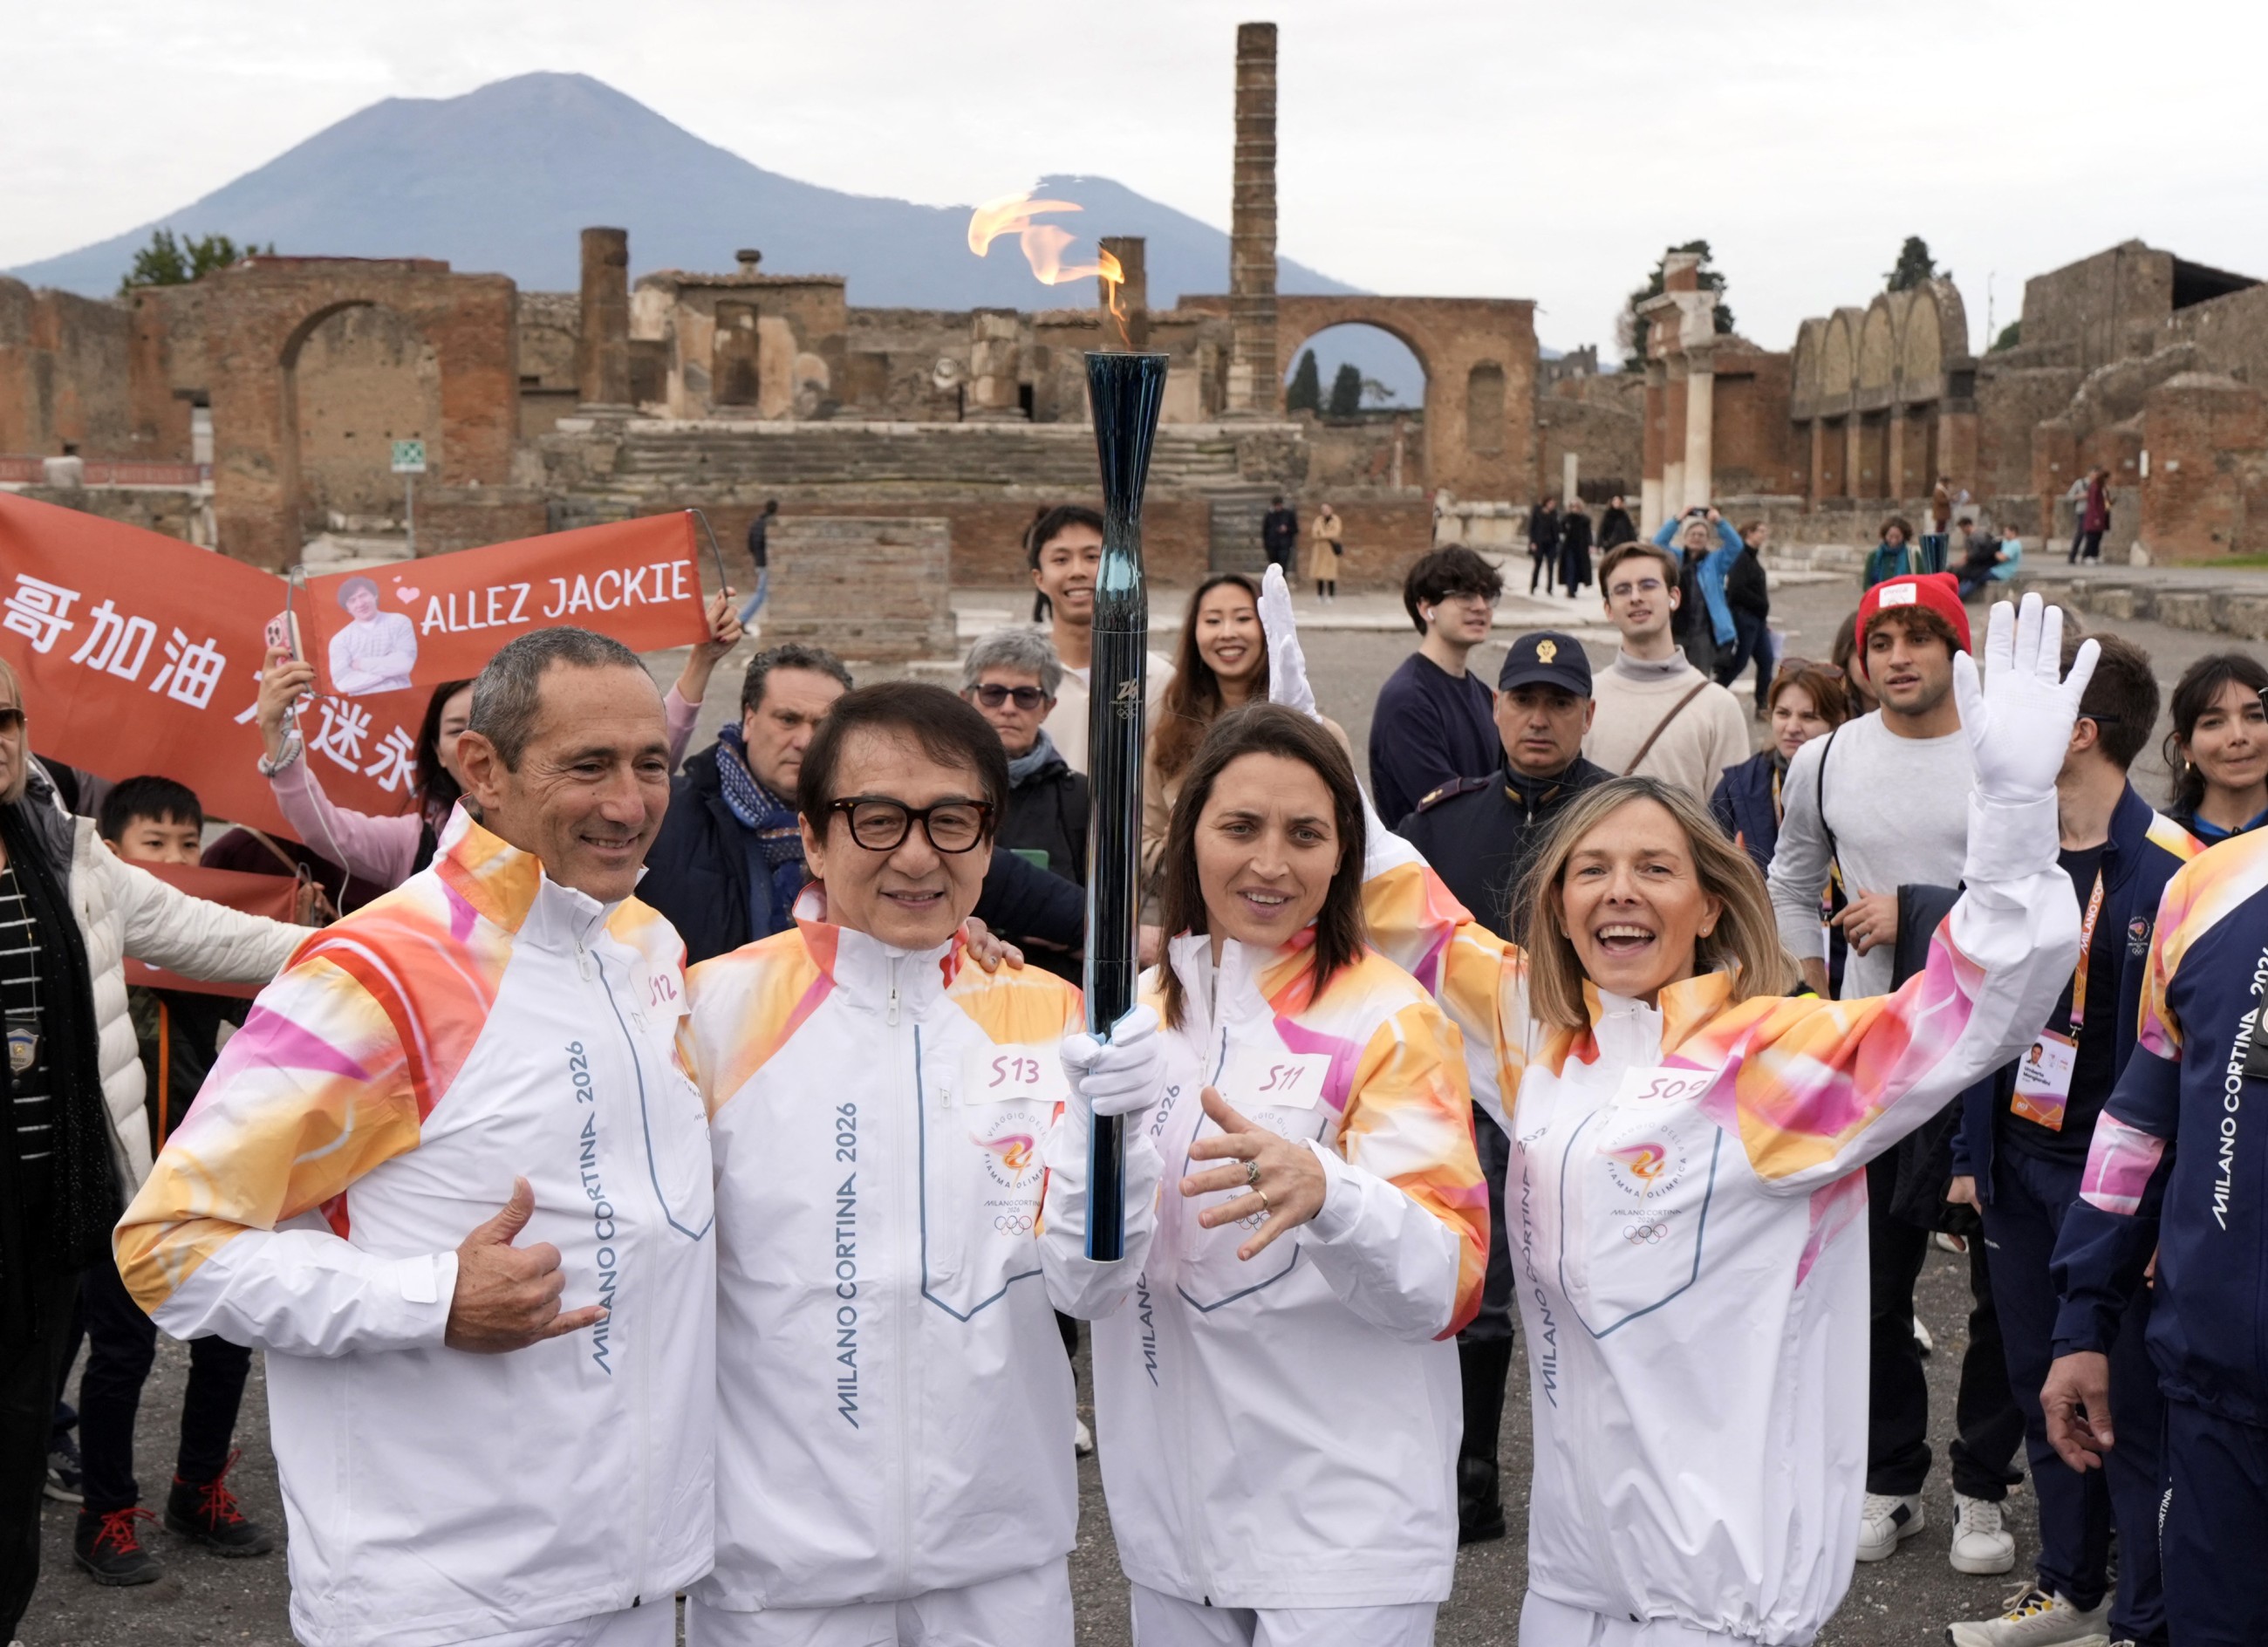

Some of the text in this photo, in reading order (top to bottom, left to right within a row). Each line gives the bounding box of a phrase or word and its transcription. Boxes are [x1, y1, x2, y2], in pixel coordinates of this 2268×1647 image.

[420, 559, 692, 635] ALLEZ JACKIE
[2, 572, 228, 710] 哥加油
[2080, 903, 2098, 955] MILANO
[648, 974, 678, 1007] S12
[988, 1055, 1041, 1088] S13
[1259, 1064, 1306, 1091] S11
[2211, 947, 2268, 1232] MILANO CORTINA 202
[987, 1111, 1047, 1138] VIAGGIO DELL
[1150, 1084, 1181, 1137] 2026
[1661, 1124, 1684, 1152] DELLA
[984, 1153, 1011, 1189] FIAMMA
[1607, 1157, 1687, 1199] FIAMMA OLIMPICA
[564, 1040, 618, 1375] MILANO CORTINA 2026
[1519, 1165, 1540, 1286] CORTINA
[835, 1102, 859, 1430] MILANO CORTINA 2026
[1534, 1286, 1559, 1410] MILANO
